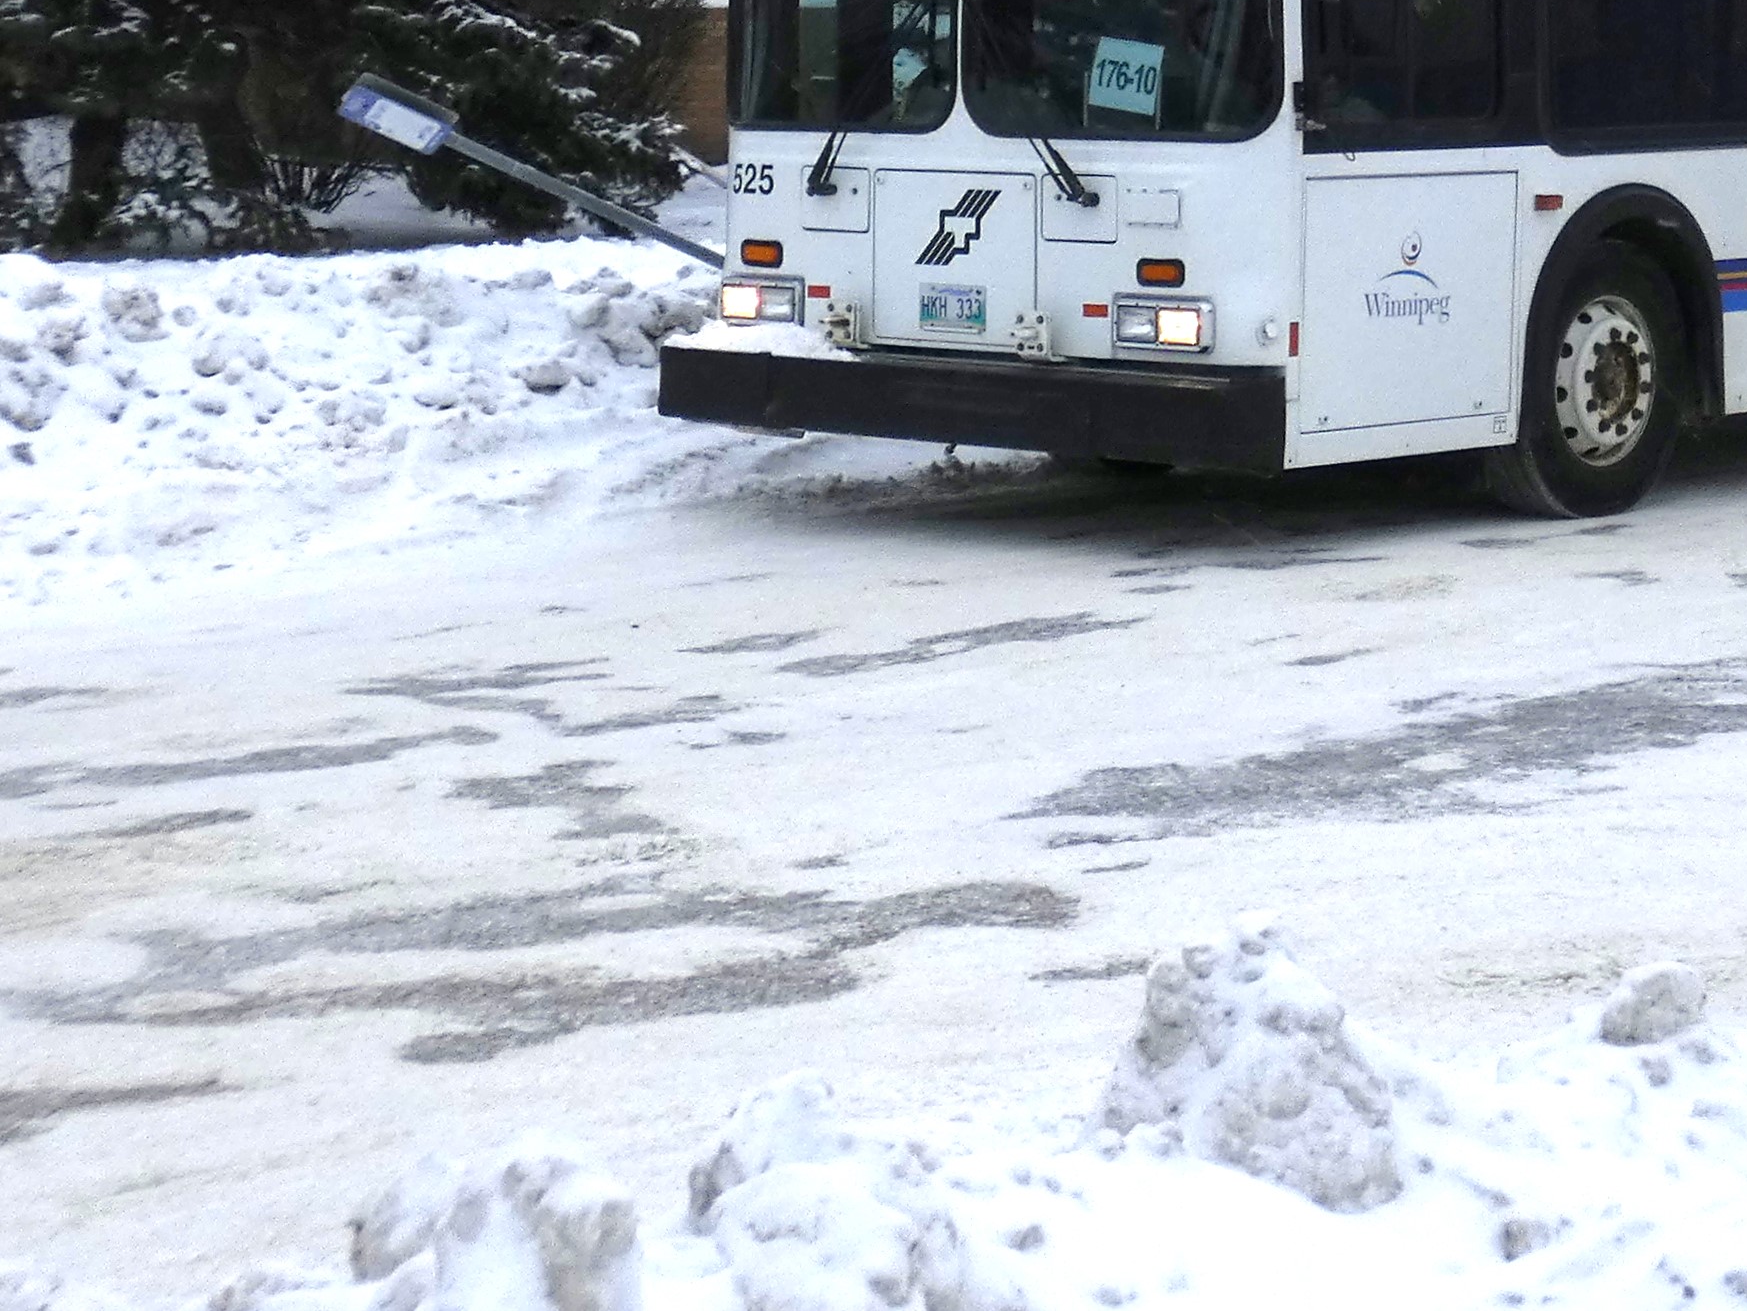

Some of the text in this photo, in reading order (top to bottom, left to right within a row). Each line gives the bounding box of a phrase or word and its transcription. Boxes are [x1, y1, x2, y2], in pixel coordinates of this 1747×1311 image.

[1096, 59, 1157, 95] 176-10
[733, 163, 774, 195] 525
[921, 295, 982, 319] HKH 333
[1364, 292, 1451, 325] Winnipeg
